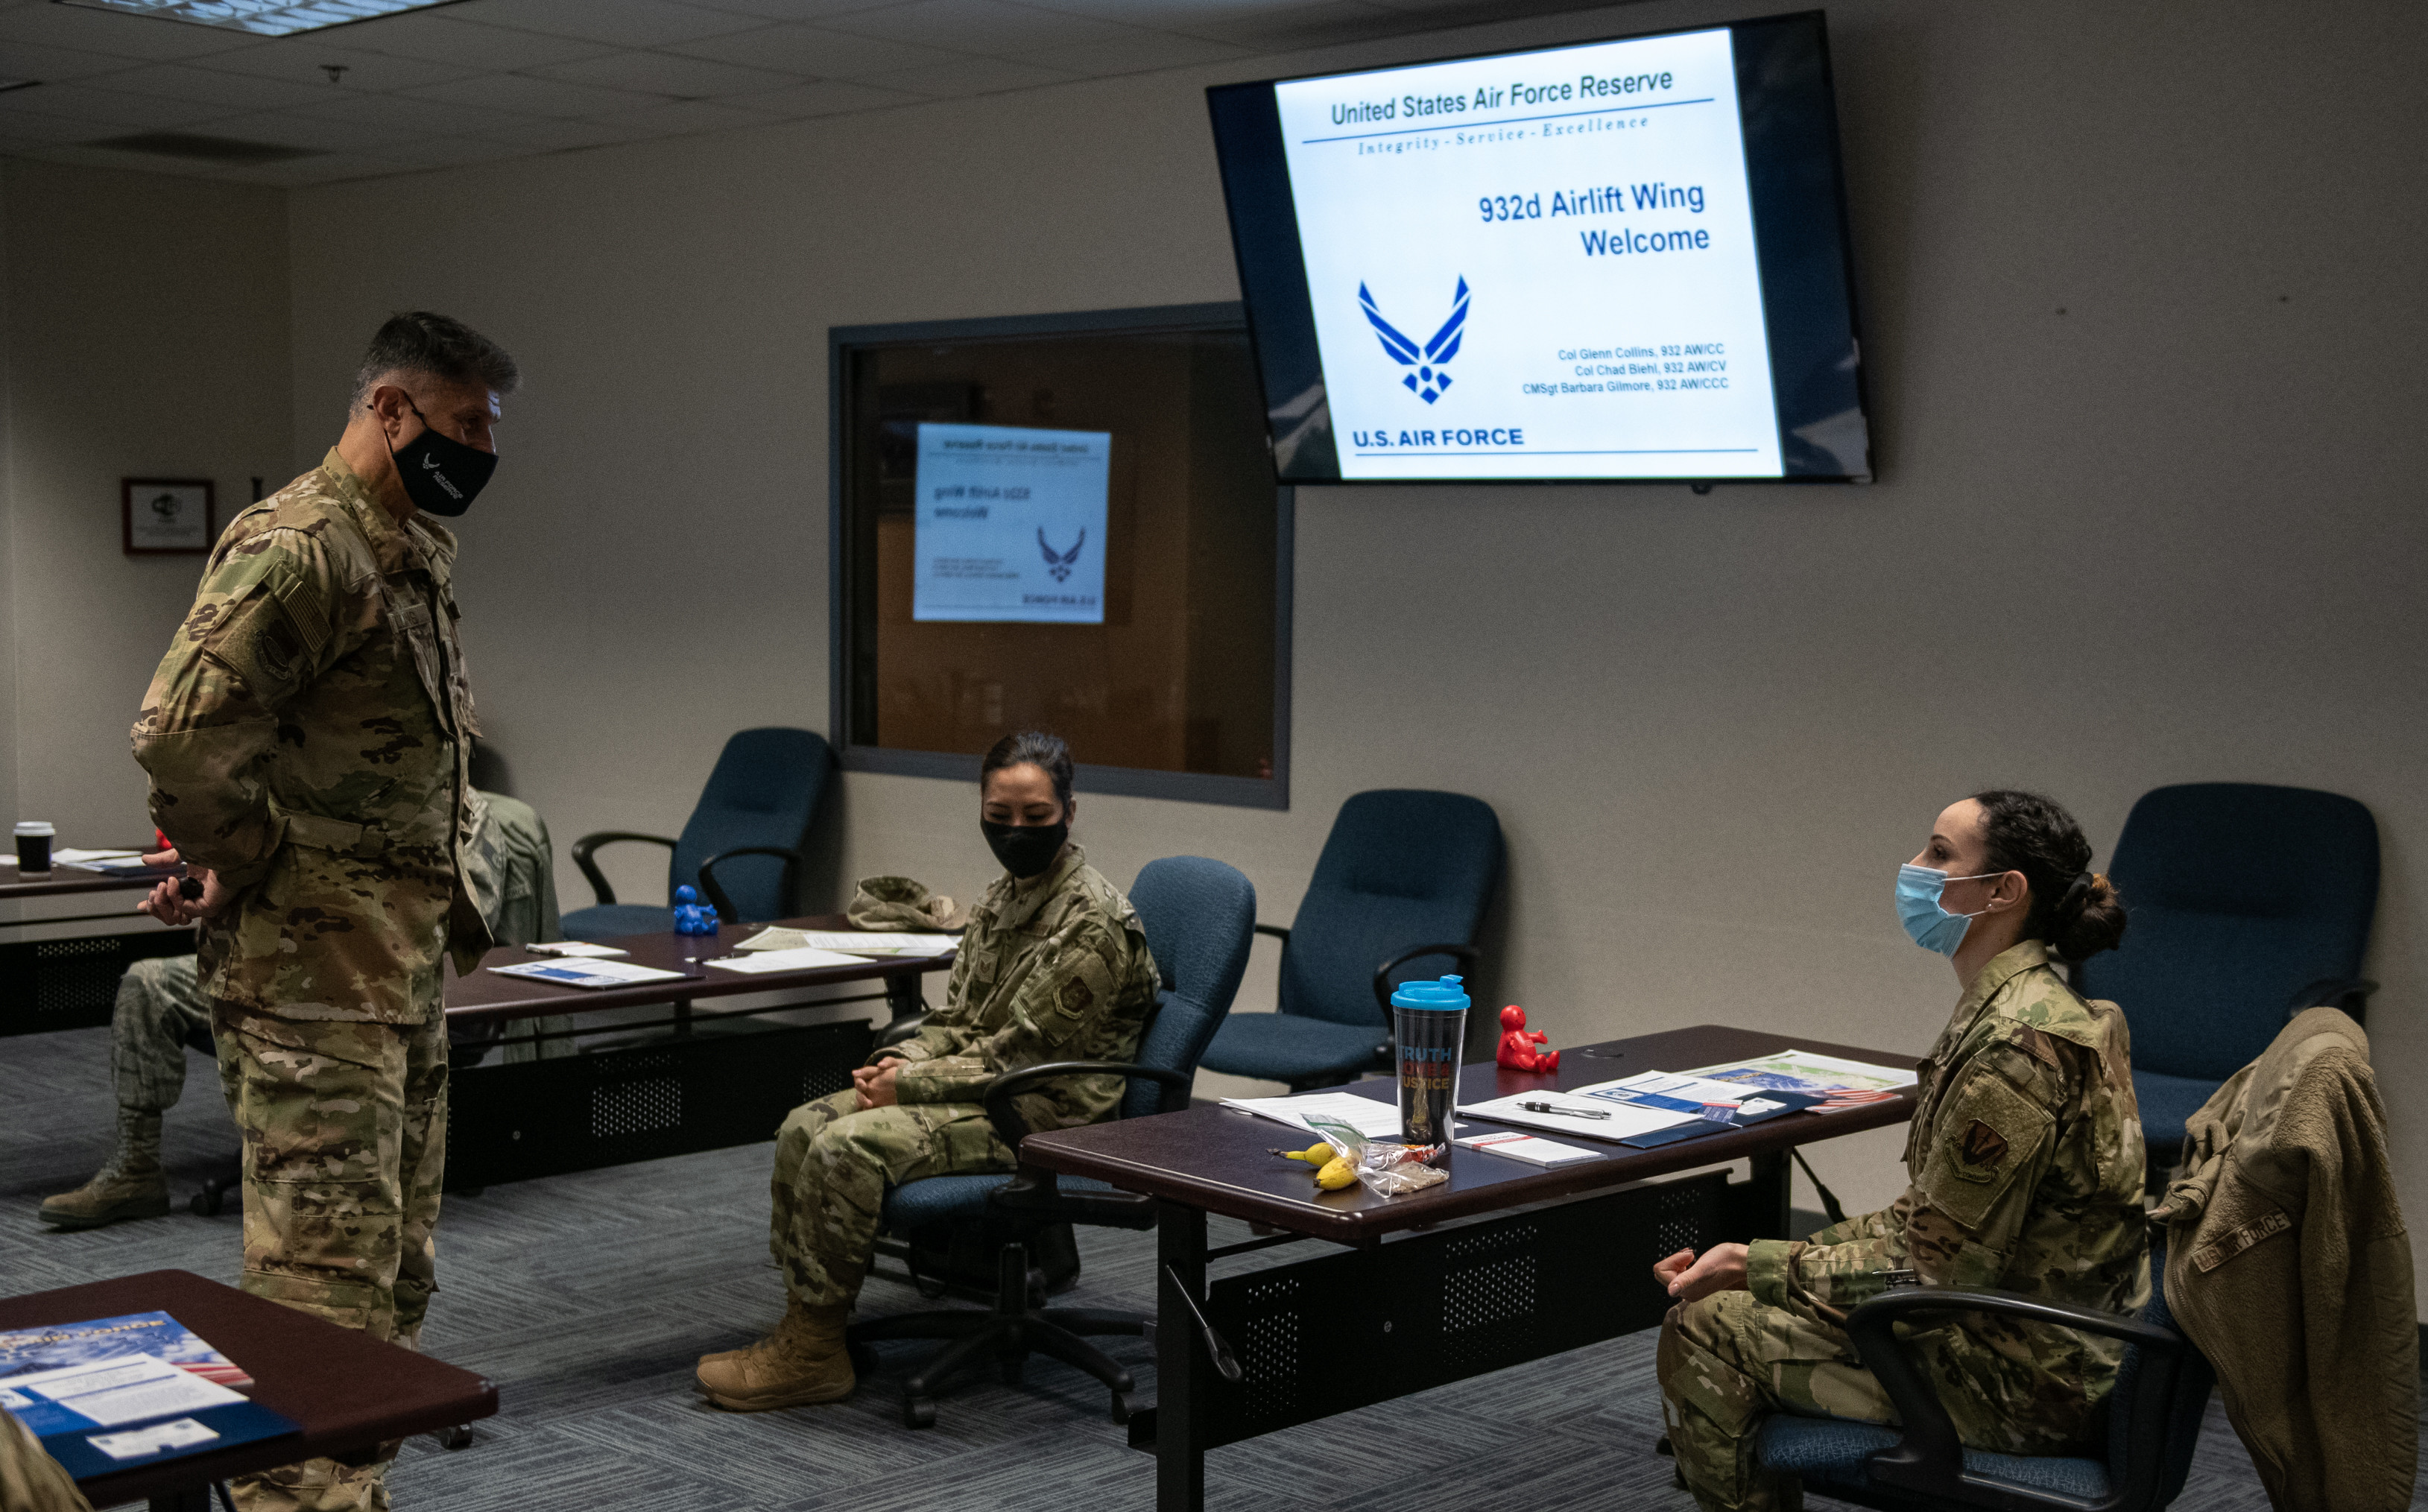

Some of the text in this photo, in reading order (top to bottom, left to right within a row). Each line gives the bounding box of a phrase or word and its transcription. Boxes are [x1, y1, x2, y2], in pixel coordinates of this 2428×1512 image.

[1332, 72, 1673, 125] United States Air Force Reserve
[1358, 136, 1439, 155] Integrity
[1456, 128, 1525, 145] Service
[1543, 117, 1648, 137] Excellence
[1479, 182, 1705, 222] 932d Airlift Wing
[1580, 228, 1710, 256] Welcome
[1558, 343, 1724, 360] Col Glenn Collins, 932 AW/CC
[1575, 360, 1727, 376] Col Chad Biehl, 932 AW/CV
[1523, 377, 1729, 396] CMSgt Barbara Gilmore, 932 AW/CCC
[1353, 428, 1525, 447] U.S. AIR FORCE
[434, 471, 446, 481] AIR
[1400, 1046, 1452, 1061] TRUTH
[1402, 1062, 1438, 1077] OVE
[1403, 1076, 1450, 1089] USTICE
[2238, 1215, 2286, 1245] FORCE
